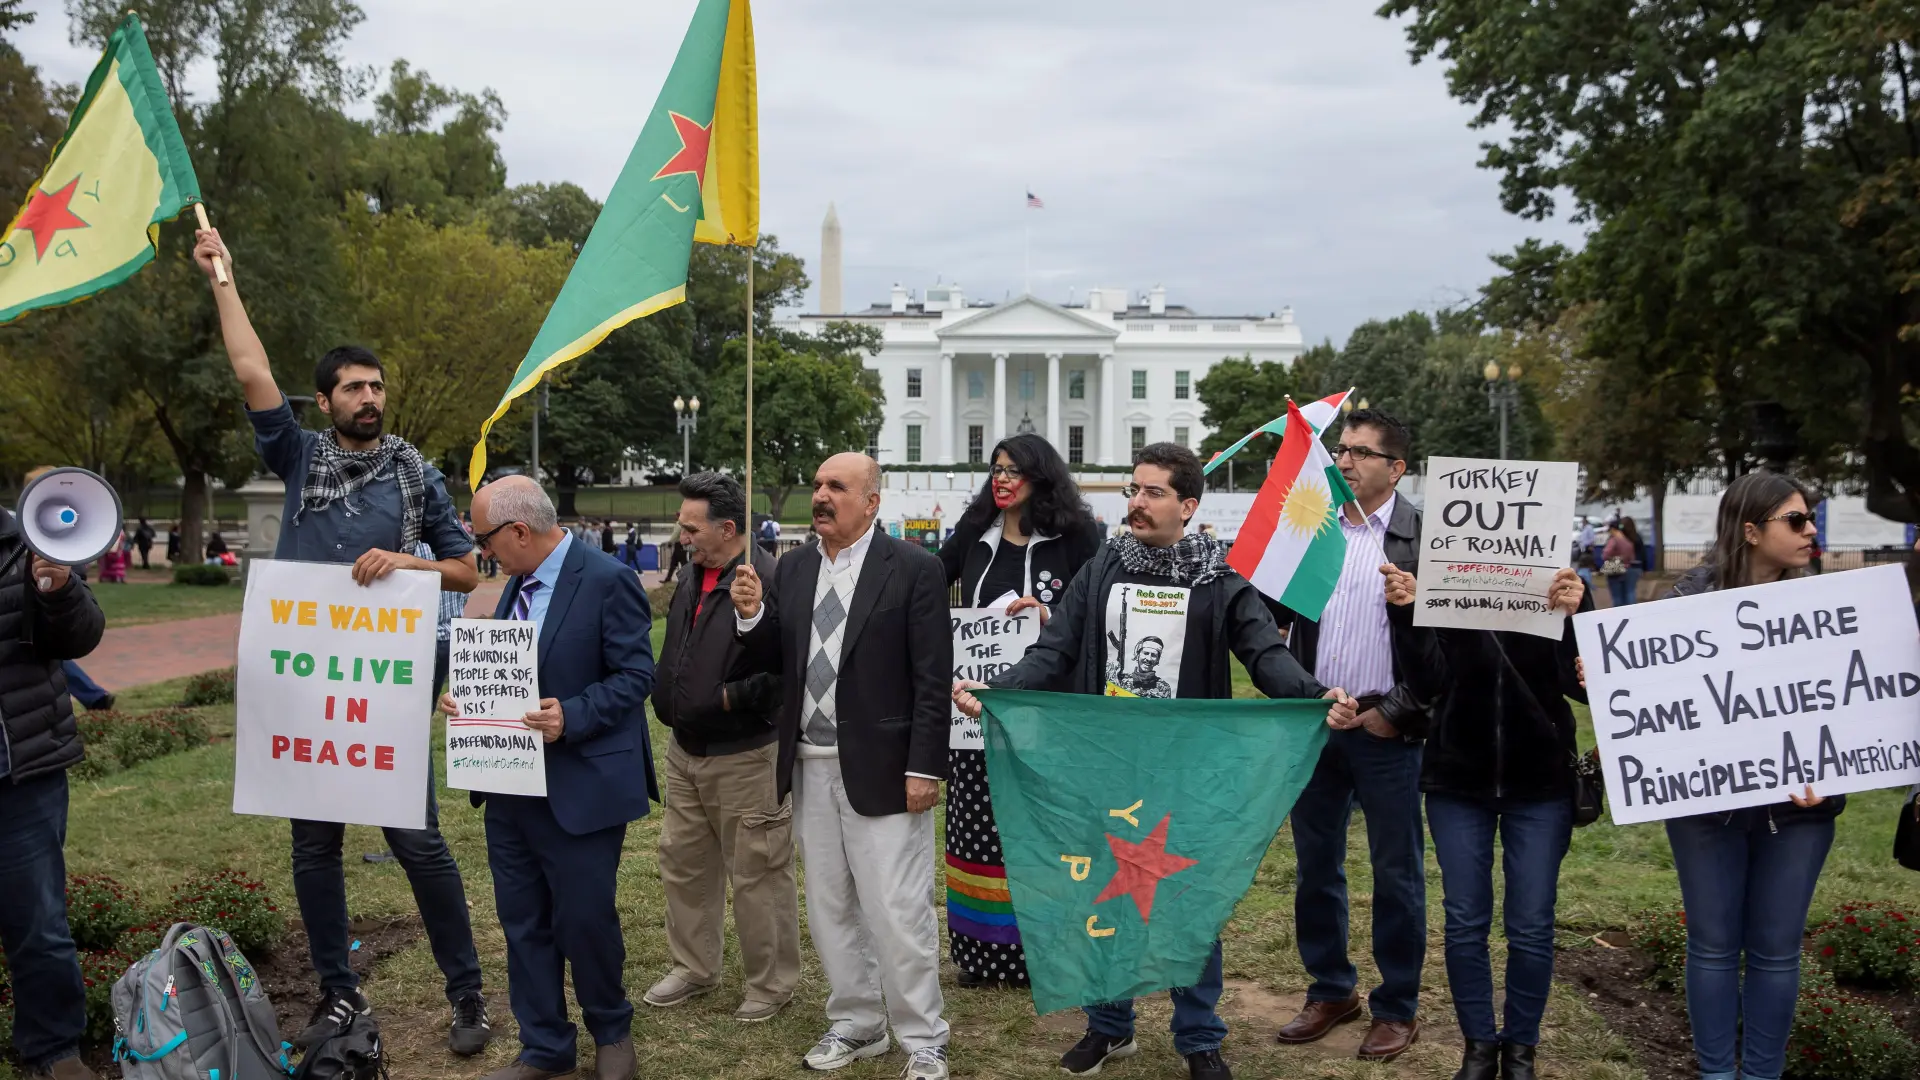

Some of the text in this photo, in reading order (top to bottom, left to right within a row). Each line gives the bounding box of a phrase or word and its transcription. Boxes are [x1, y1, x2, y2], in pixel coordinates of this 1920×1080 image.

[1439, 466, 1539, 497] TURKEY
[1442, 500, 1543, 531] OUT
[1430, 535, 1557, 559] OF ROJAVA!
[1447, 564, 1533, 578] #DEFENDROJAVA
[1136, 589, 1155, 598] Rob
[1425, 598, 1452, 608] STOP
[1455, 597, 1503, 611] KILLING
[270, 599, 423, 633] WE WANT
[951, 616, 1029, 641] PROTECT
[455, 626, 533, 652] DON'T BETRAY
[1598, 600, 1858, 673] KURDS SHARE
[453, 648, 518, 664] THE KURDISH
[966, 643, 1002, 659] THE
[270, 650, 413, 685] TO LIVE
[453, 667, 533, 686] PEOPLE OR SDF,
[452, 684, 529, 699] WHO DEFEATED
[1609, 649, 1920, 739] SAME VALUES AND
[325, 696, 368, 723] IN
[272, 735, 395, 771] PEACE
[449, 734, 537, 752] #DEFENDROJAVA
